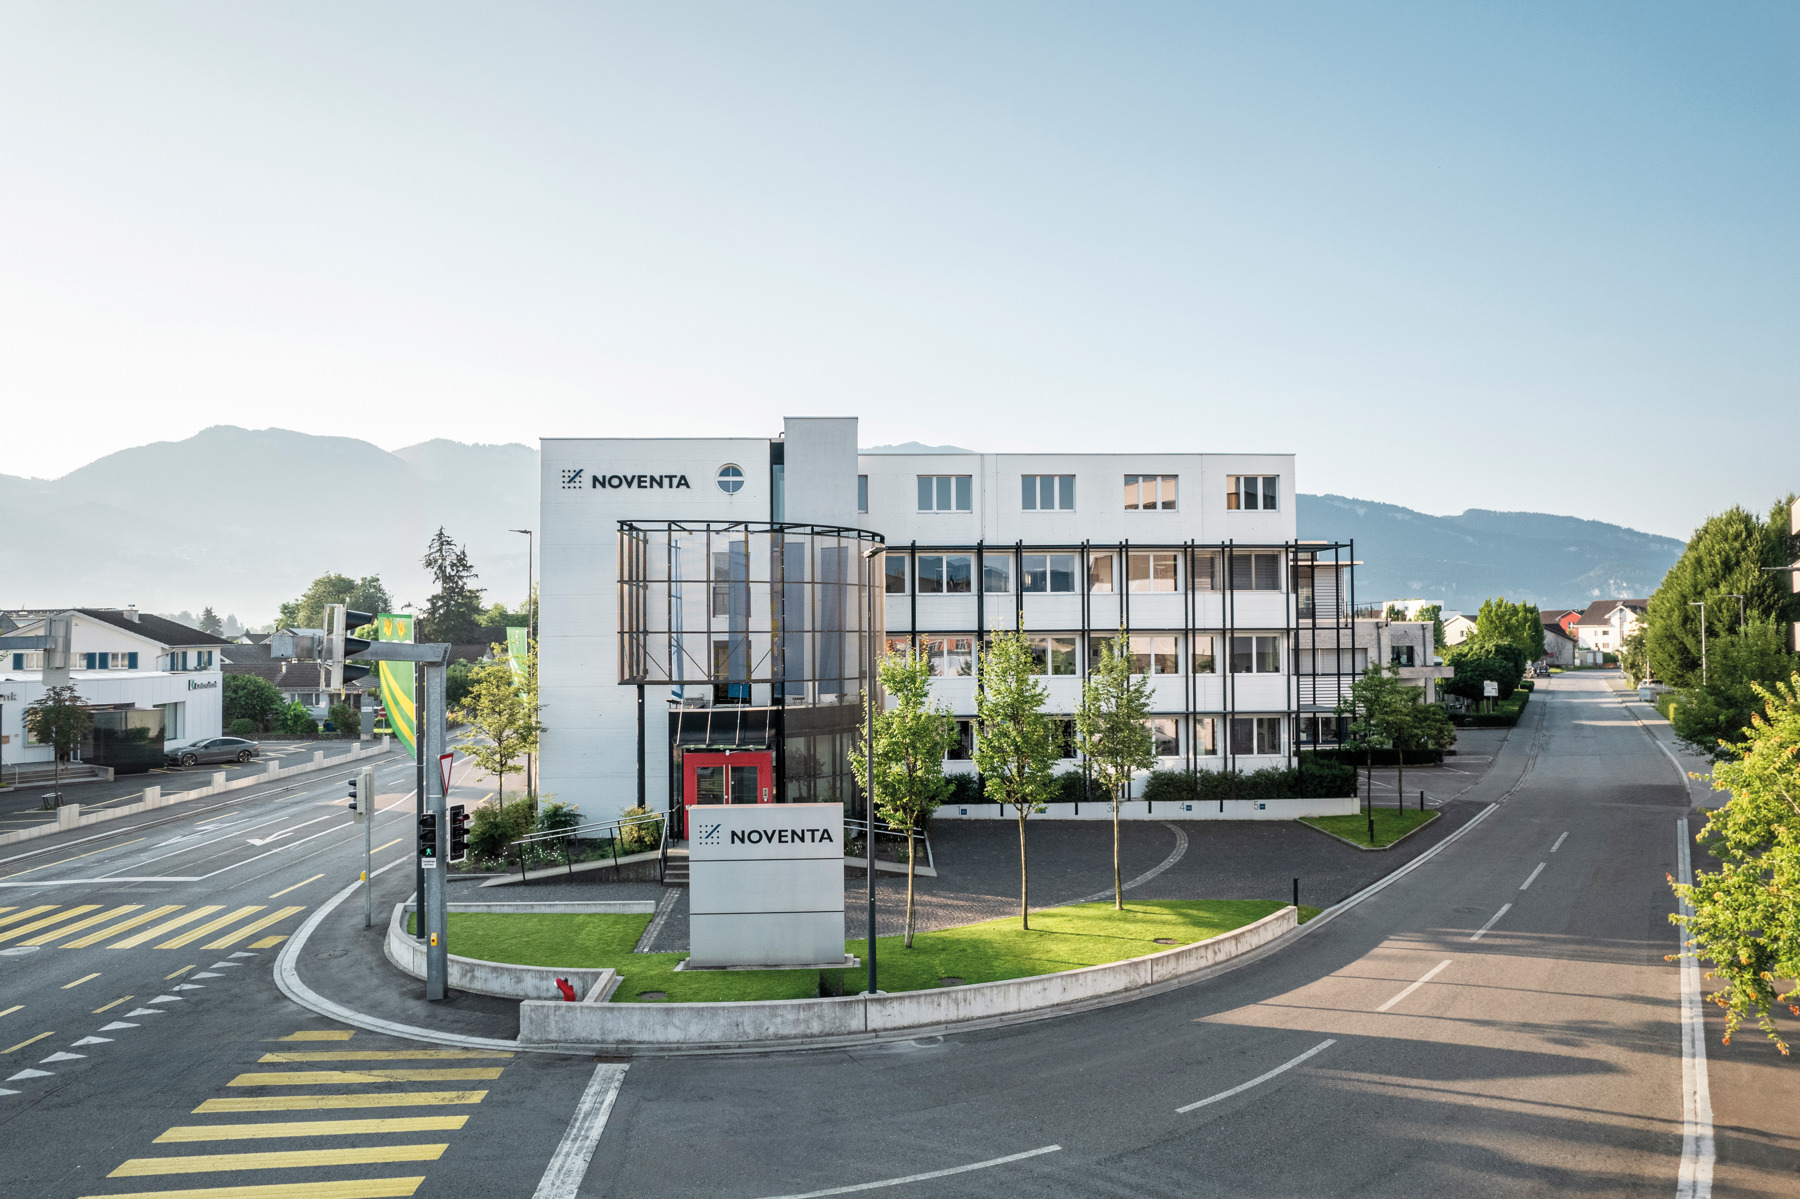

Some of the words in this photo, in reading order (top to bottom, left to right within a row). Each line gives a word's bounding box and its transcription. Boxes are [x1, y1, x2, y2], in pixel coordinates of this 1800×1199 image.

[592, 474, 690, 489] NOVENTA
[1106, 803, 1113, 813] 3
[1179, 802, 1185, 812] 4
[1253, 801, 1259, 811] 5
[731, 829, 833, 844] NOVENTA
